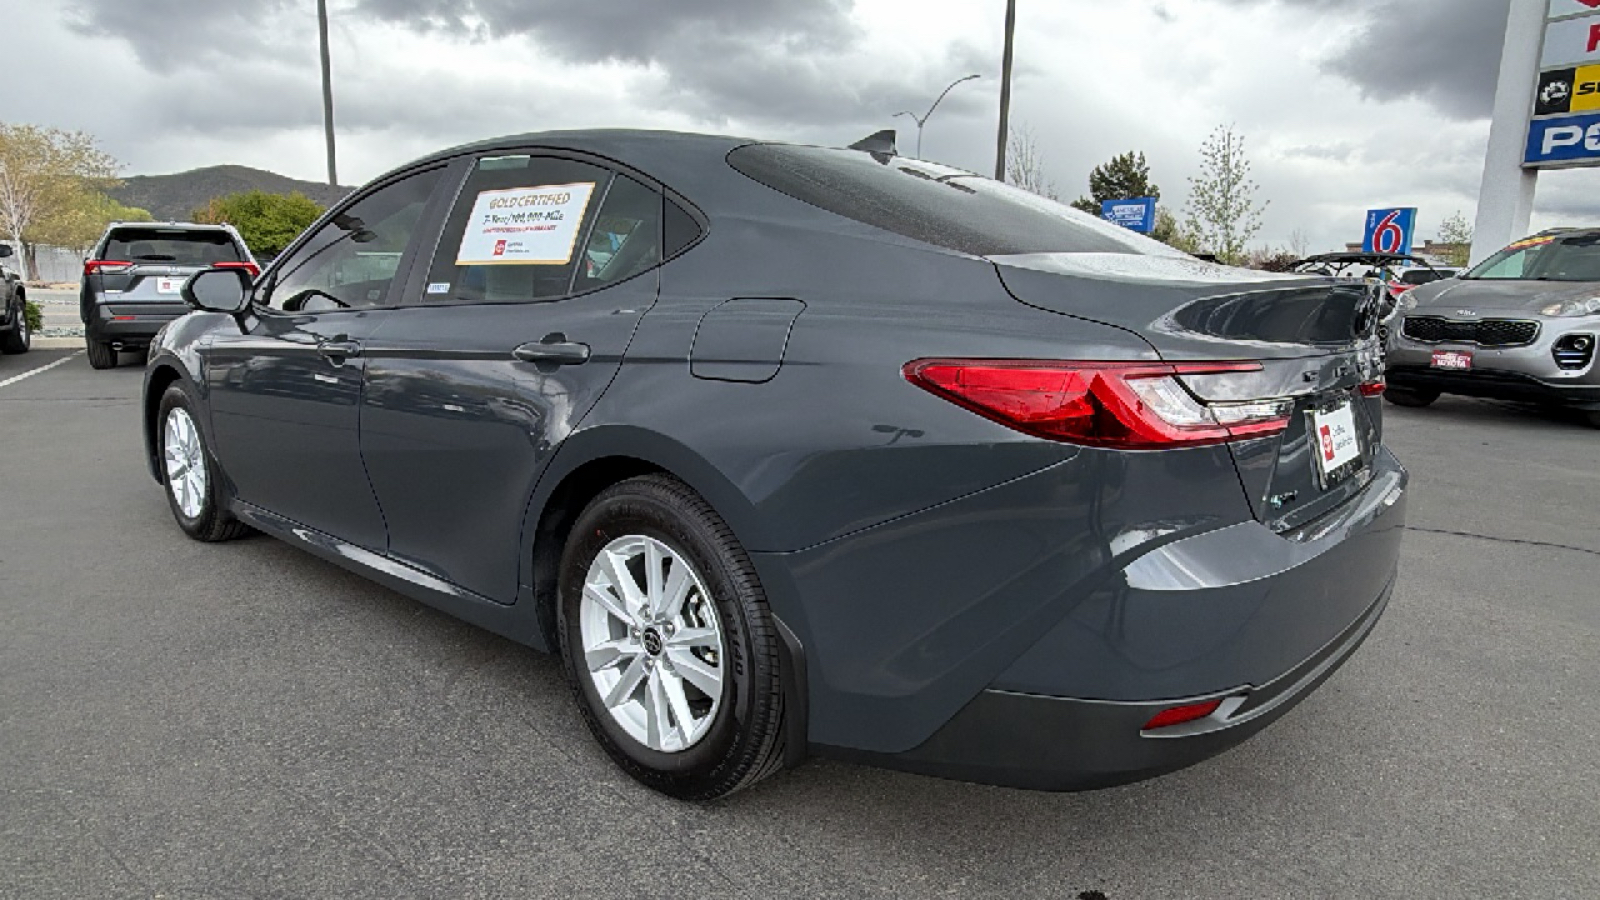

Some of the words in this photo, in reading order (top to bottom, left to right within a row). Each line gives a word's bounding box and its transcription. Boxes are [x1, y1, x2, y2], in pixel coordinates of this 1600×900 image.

[1576, 81, 1600, 96] S
[490, 196, 515, 209] GOLD
[519, 192, 571, 207] CERTIFIED
[1372, 209, 1403, 253] 6
